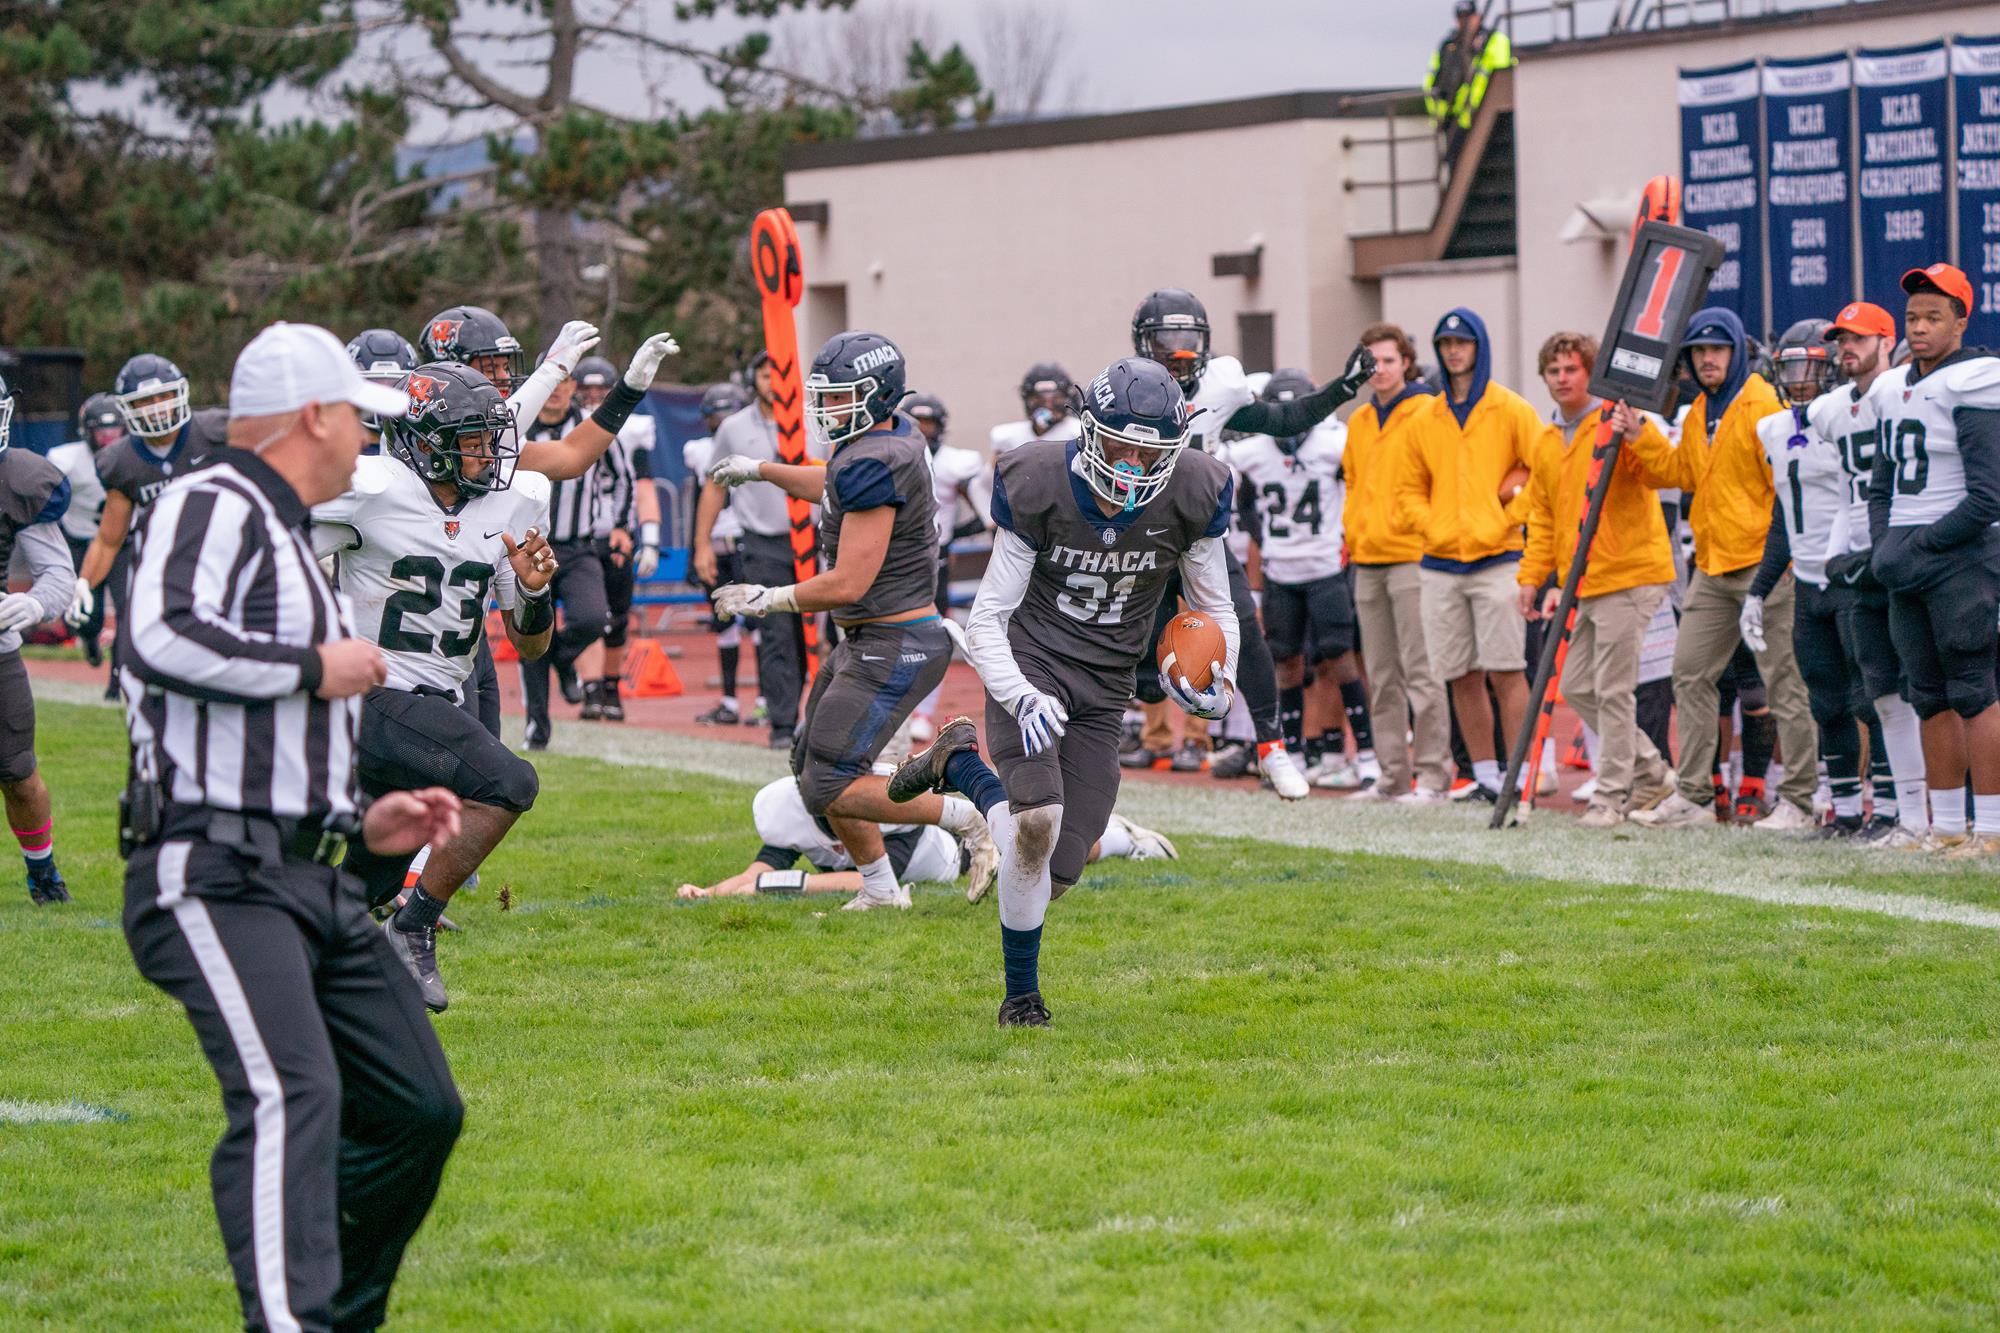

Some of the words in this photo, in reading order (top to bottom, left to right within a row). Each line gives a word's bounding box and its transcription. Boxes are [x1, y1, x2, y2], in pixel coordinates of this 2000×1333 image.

[1881, 93, 1921, 126] NCAA
[1865, 127, 1938, 162] NATIONAL
[1861, 162, 1942, 198] CHAMPIONS
[1633, 246, 1685, 339] 1
[853, 345, 899, 375] ITHACA
[1263, 480, 1322, 537] 24
[1787, 459, 1804, 534] 1
[1050, 545, 1157, 572] ITHACA
[378, 555, 496, 657] 23
[1056, 573, 1137, 623] 31
[900, 652, 928, 664] ITHACA
